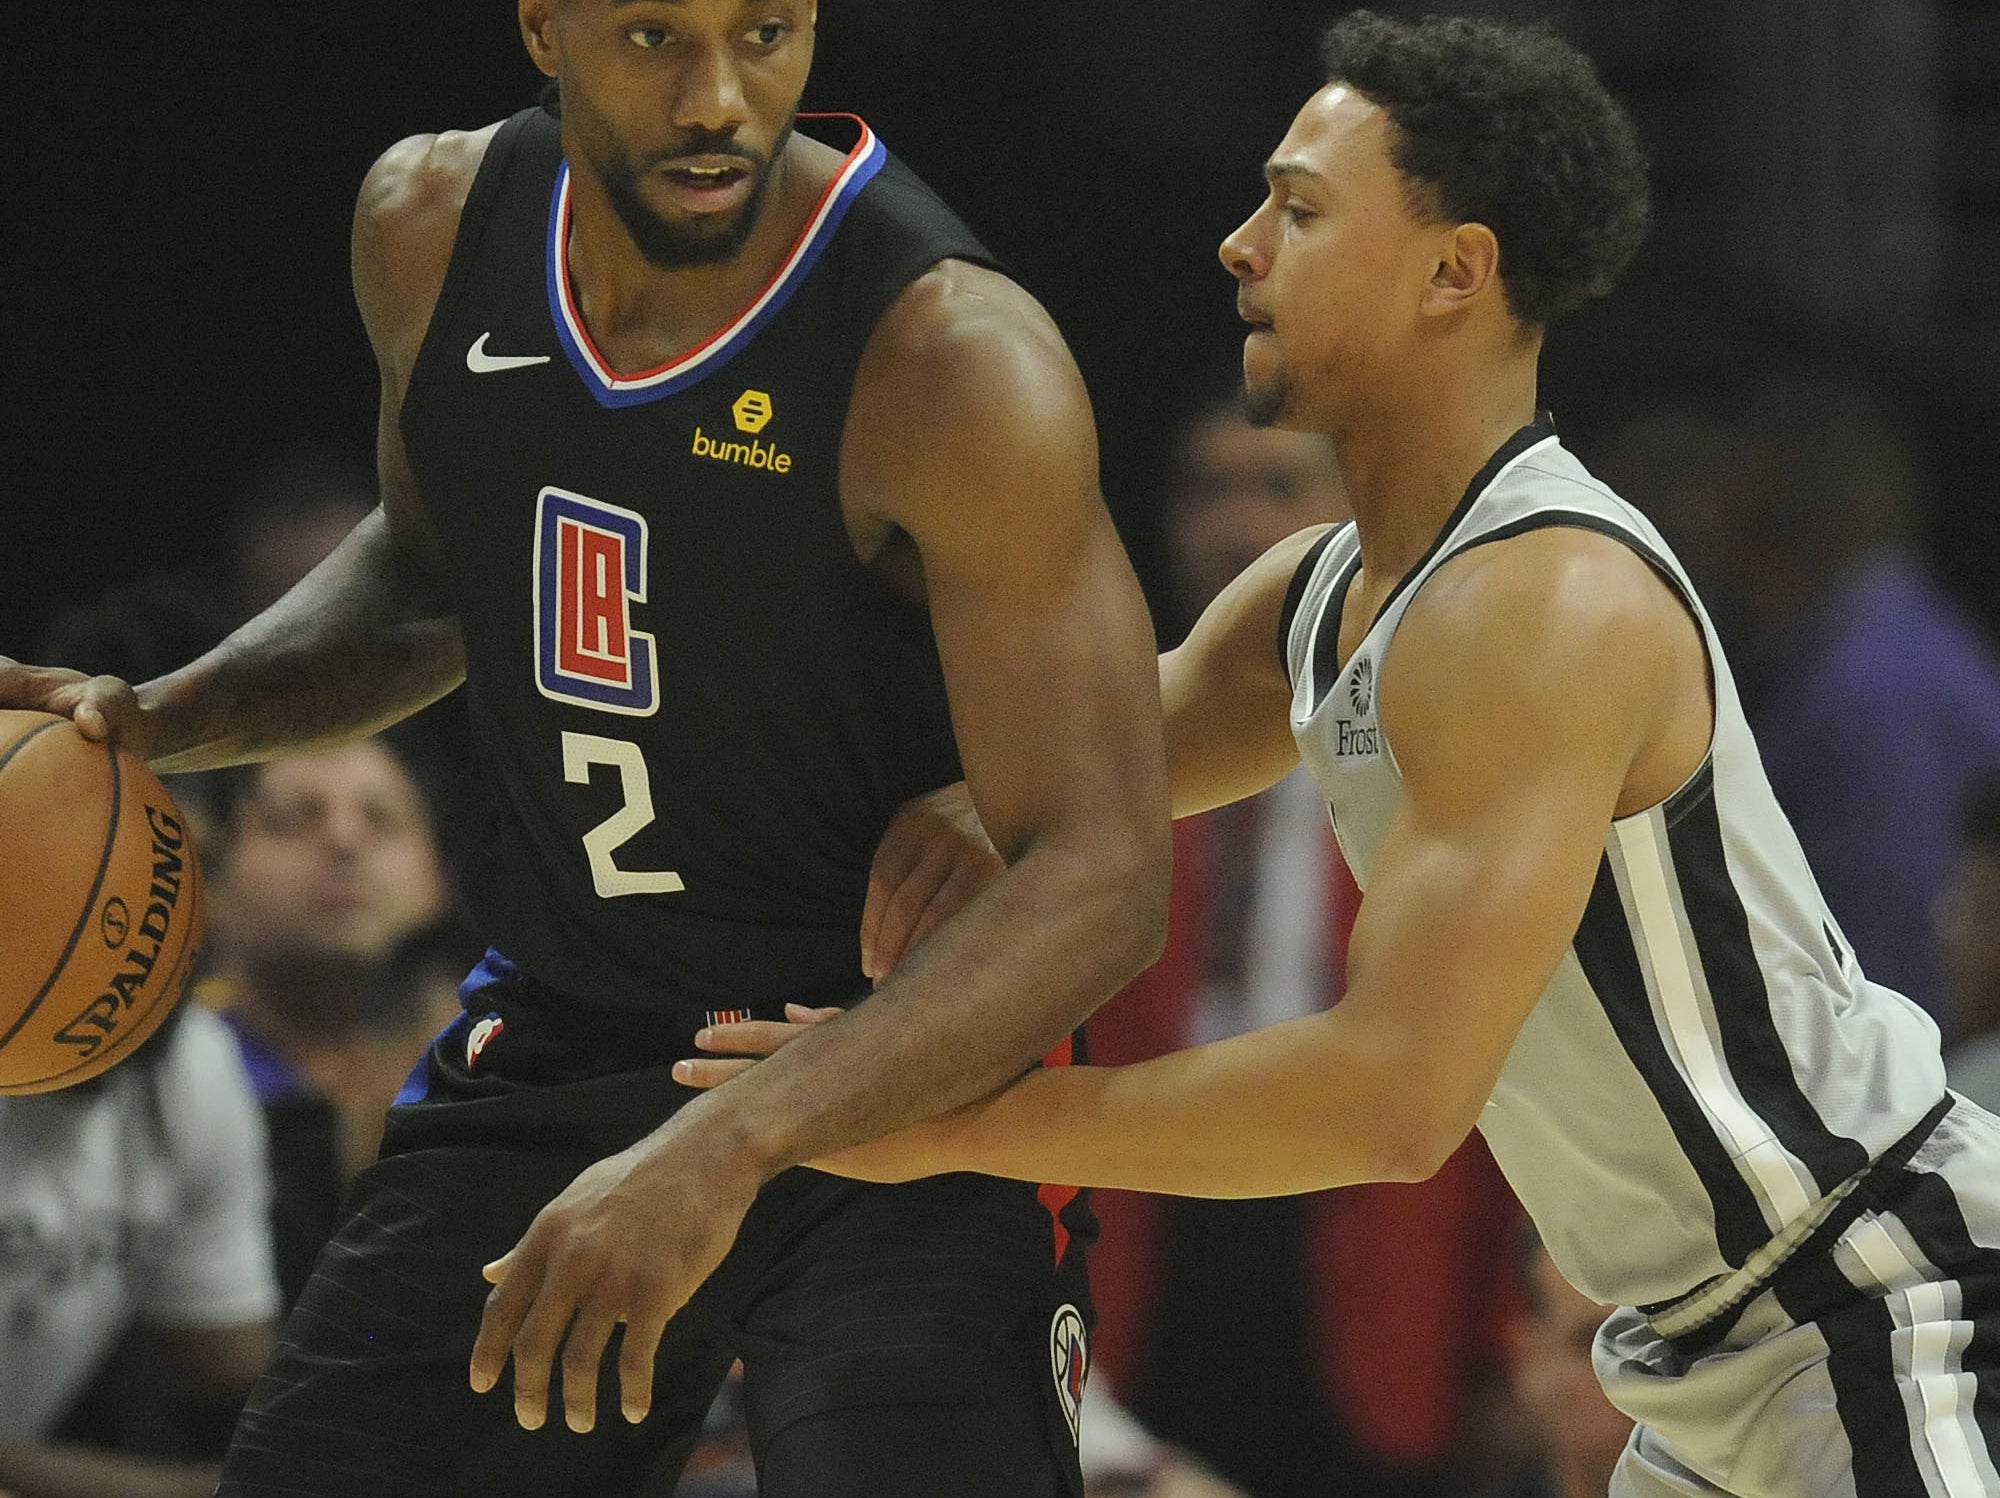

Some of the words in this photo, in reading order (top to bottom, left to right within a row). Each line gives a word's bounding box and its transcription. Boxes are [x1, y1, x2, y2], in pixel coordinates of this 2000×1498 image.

[691, 428, 792, 473] bumble
[1336, 720, 1379, 756] Frost
[561, 731, 685, 898] 2
[53, 805, 184, 1057] SPALDING
